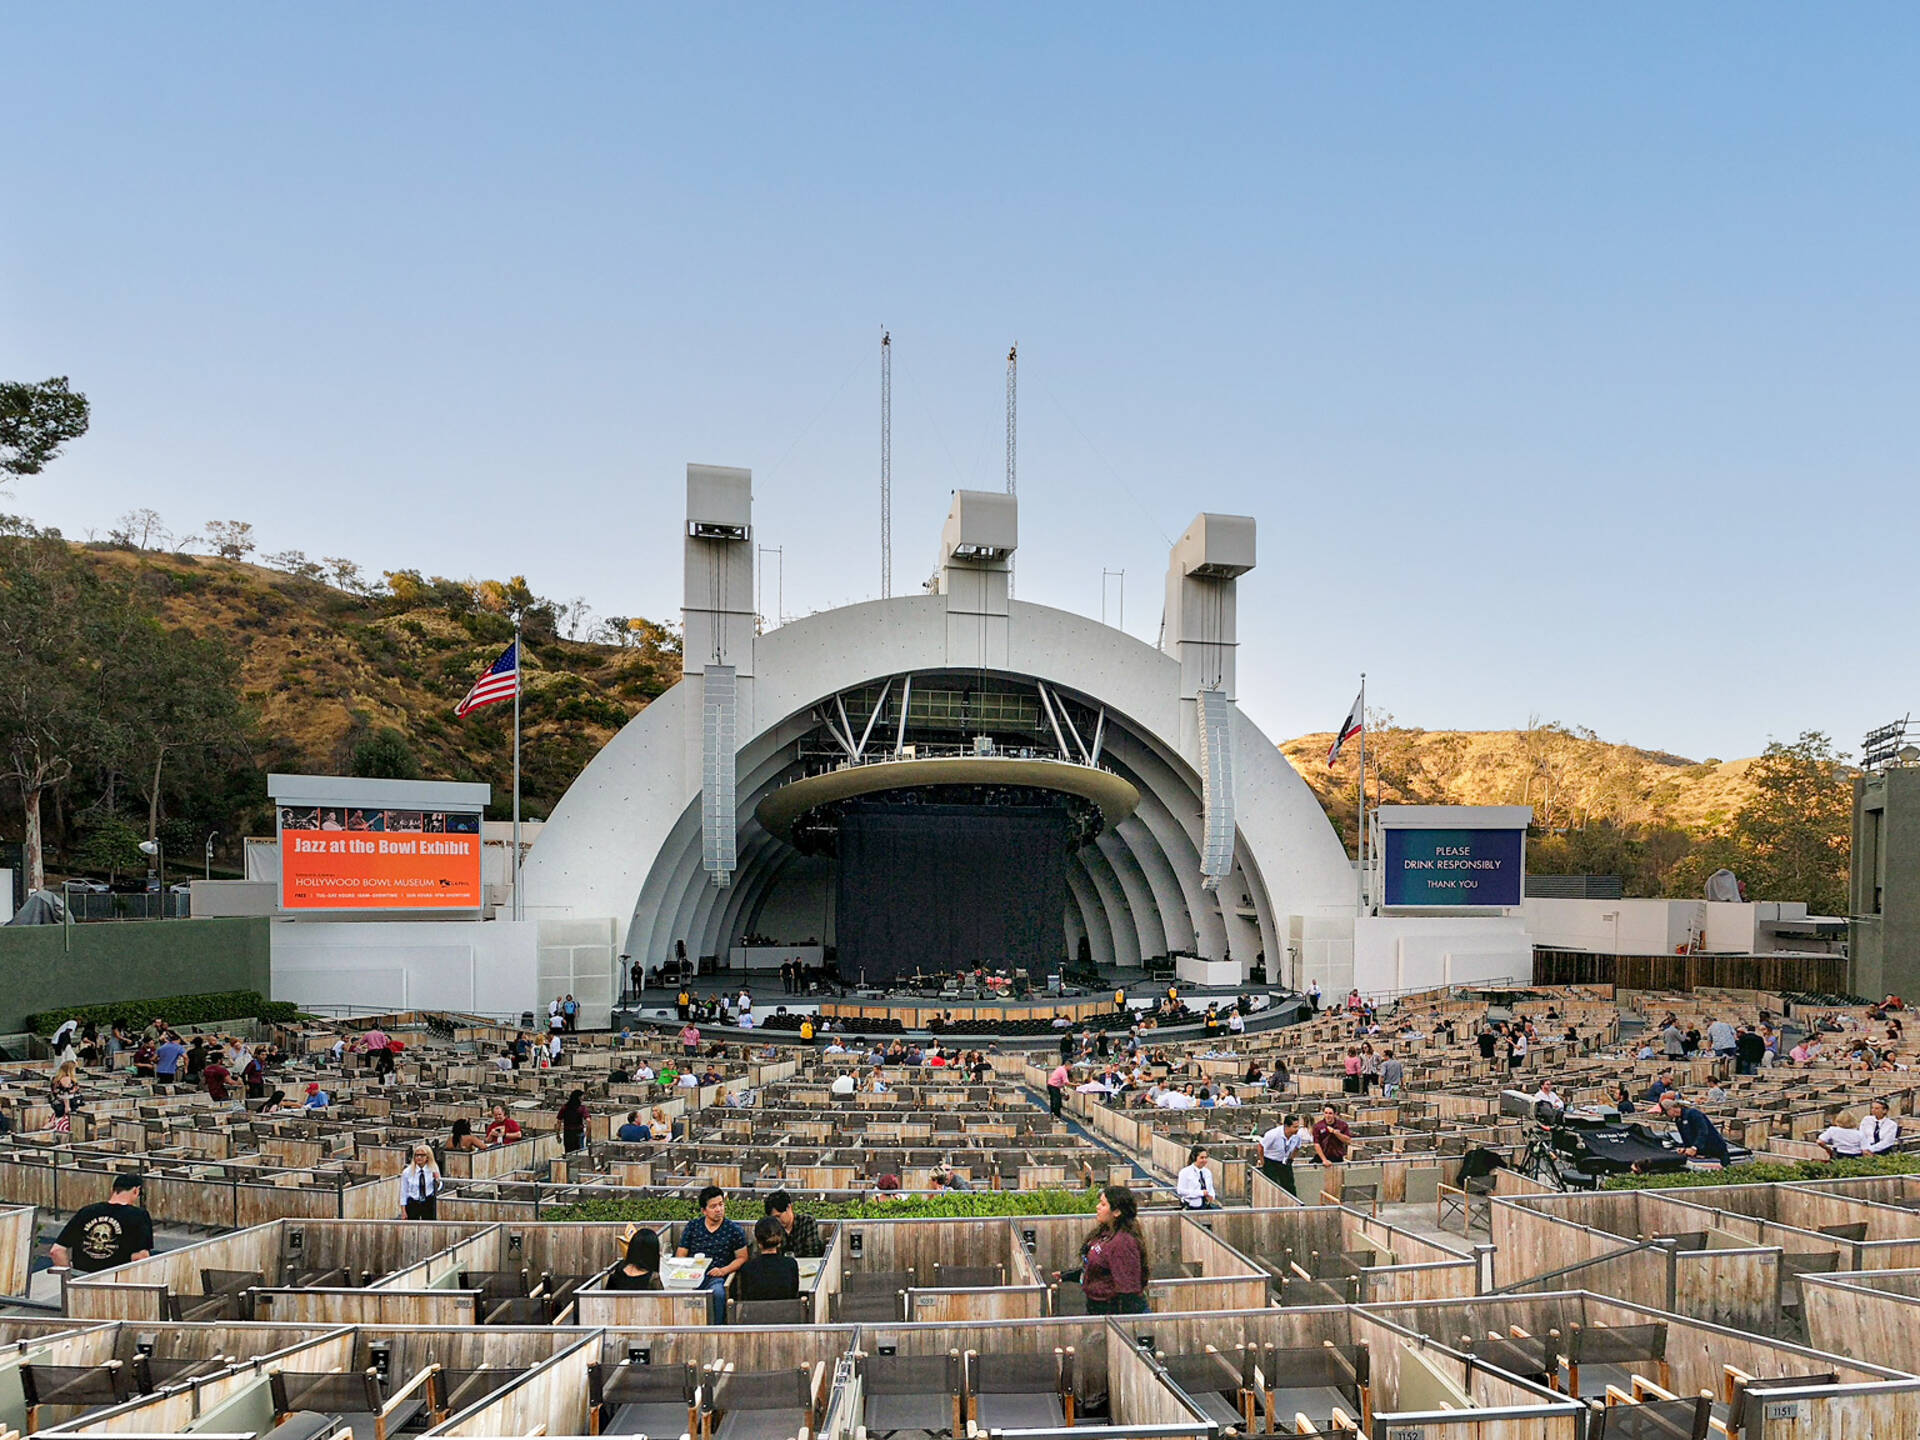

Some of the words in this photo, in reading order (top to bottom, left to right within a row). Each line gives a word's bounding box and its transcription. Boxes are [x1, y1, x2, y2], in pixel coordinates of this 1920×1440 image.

[294, 837, 327, 853] Jazz
[329, 840, 346, 854] at
[349, 839, 375, 854] the
[379, 839, 416, 855] Bowl
[419, 840, 470, 855] Exhibit
[1435, 846, 1470, 856] PLEASE
[1404, 860, 1434, 870] DRINK
[1437, 860, 1501, 870] RESPONSIBLY
[295, 878, 360, 888] HOLLYWOOD
[363, 878, 391, 888] BOWL
[394, 878, 435, 888] MUSEUM
[1427, 879, 1456, 889] THANK
[1459, 880, 1478, 889] YOU
[1774, 1407, 1791, 1416] 1151
[1399, 1430, 1418, 1440] 1152
